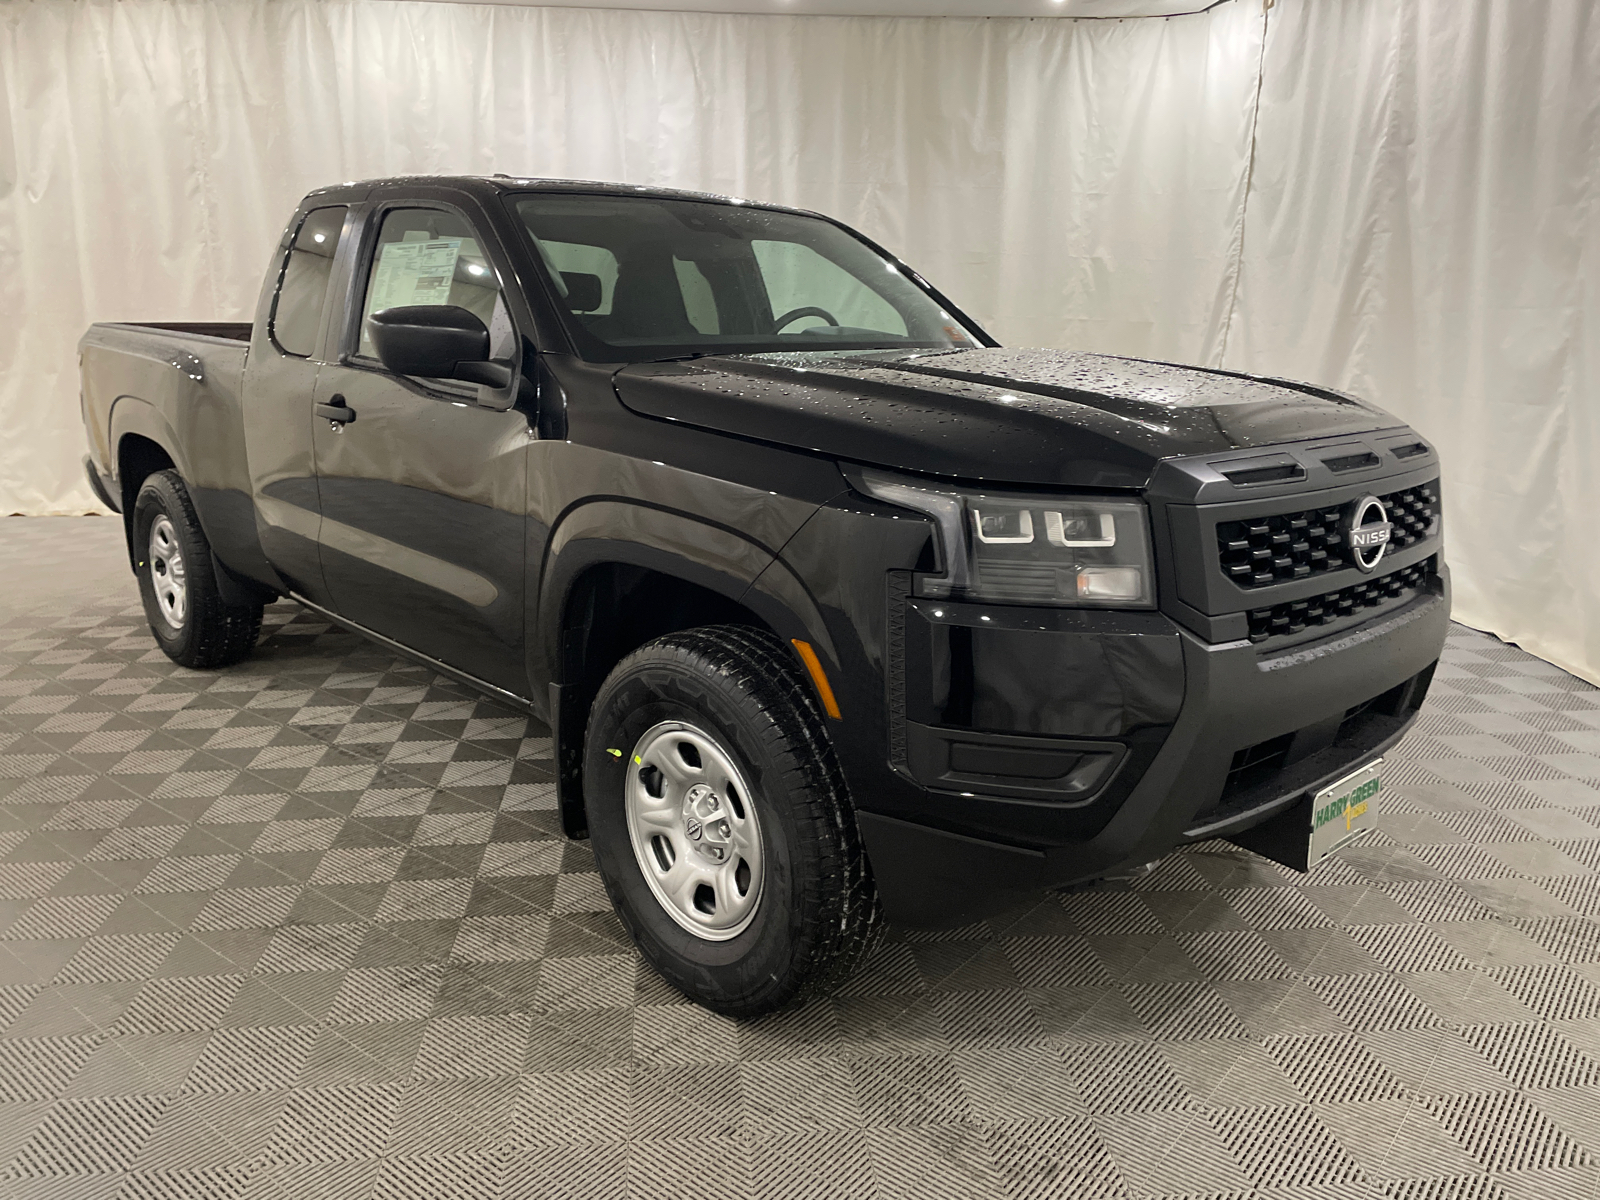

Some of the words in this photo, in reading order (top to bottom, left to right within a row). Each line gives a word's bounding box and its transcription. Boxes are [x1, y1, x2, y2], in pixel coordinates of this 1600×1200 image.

[1353, 529, 1390, 545] NISSA
[1315, 793, 1350, 831] HARRY
[1350, 776, 1380, 808] GREEN
